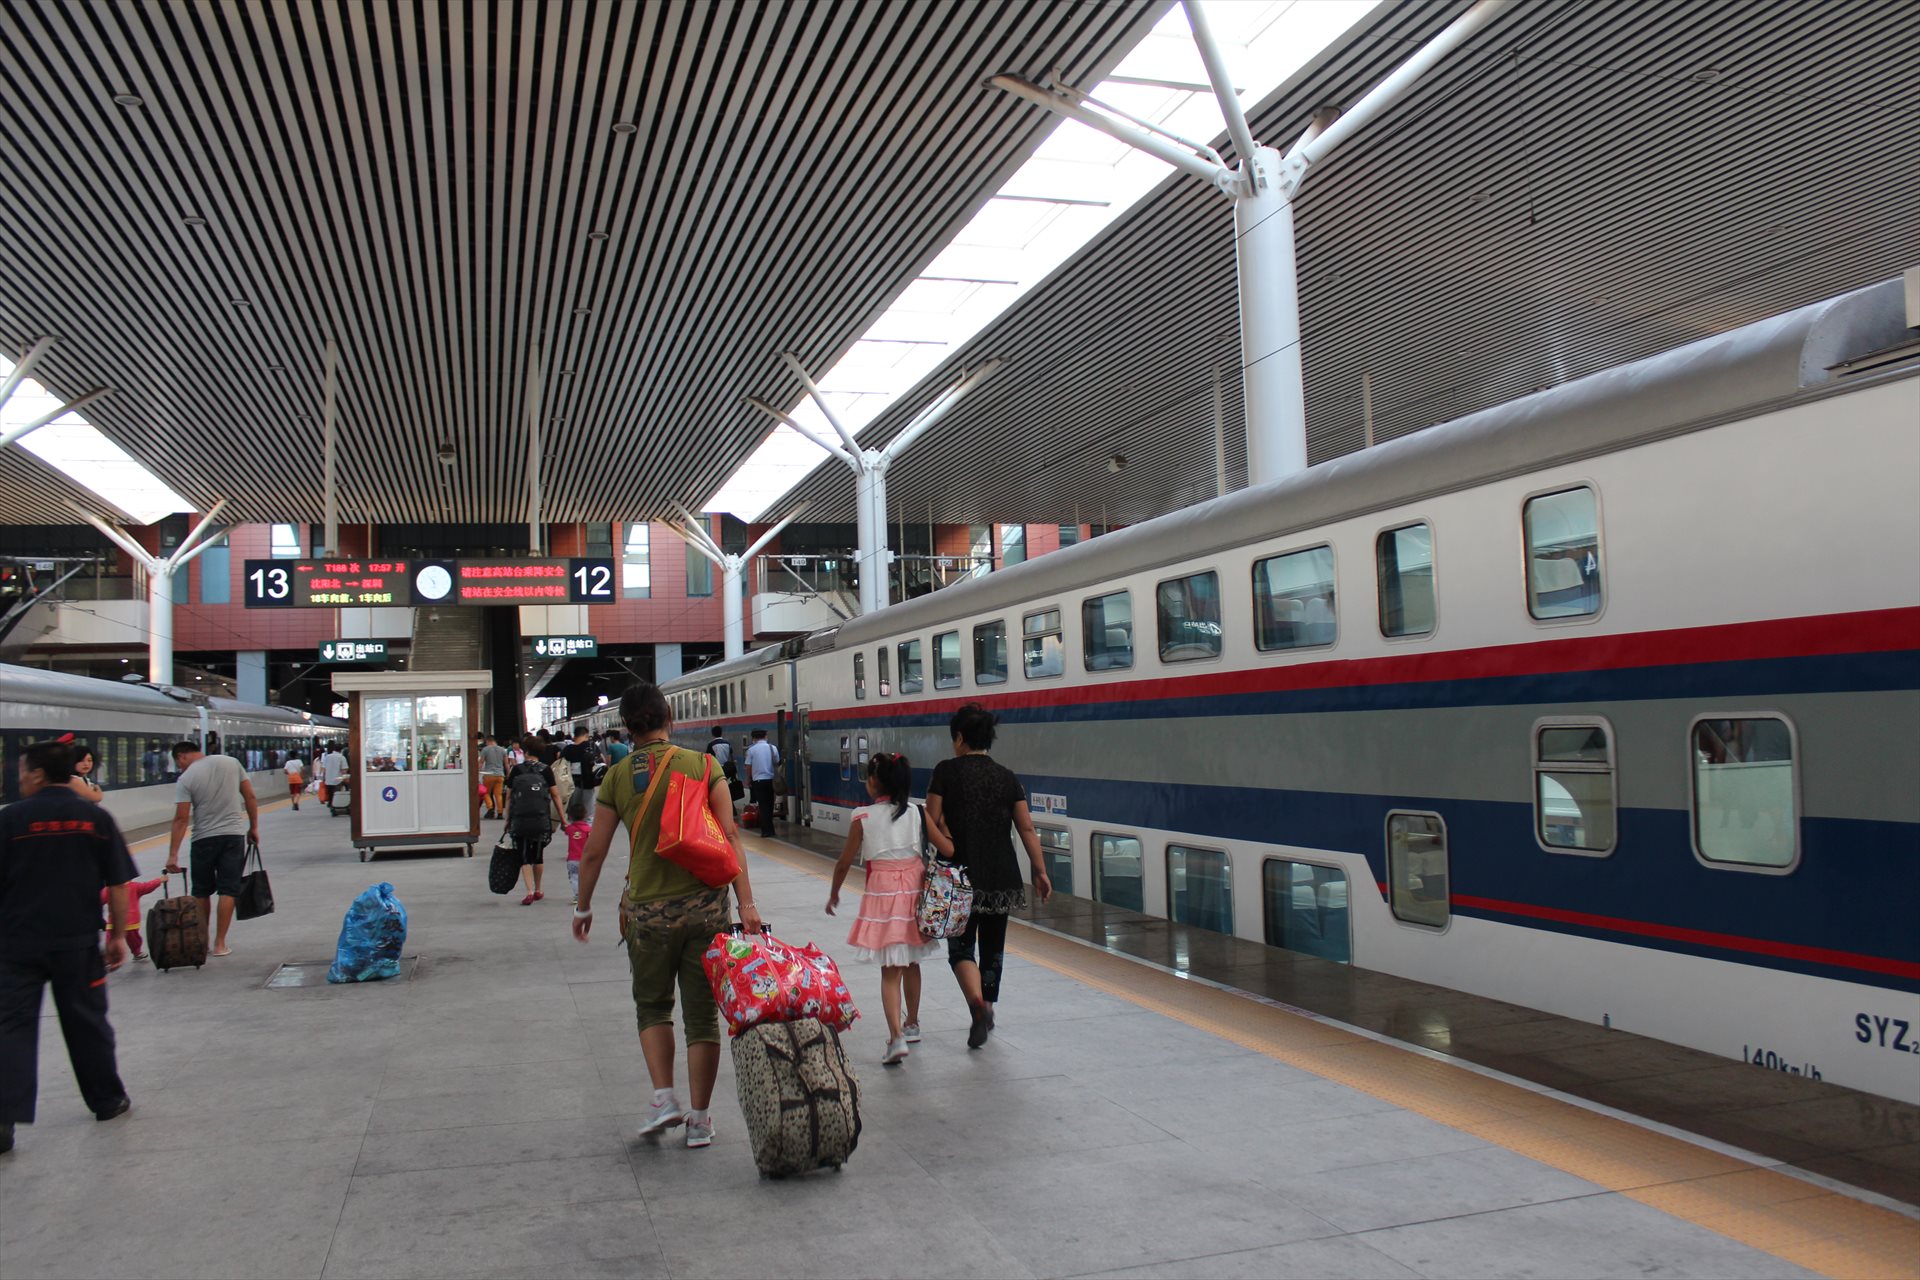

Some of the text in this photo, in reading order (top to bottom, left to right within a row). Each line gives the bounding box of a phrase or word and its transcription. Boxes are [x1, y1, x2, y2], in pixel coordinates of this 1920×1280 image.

[368, 563, 392, 573] 17:57
[250, 568, 289, 599] 13
[574, 566, 611, 596] 12
[461, 586, 566, 598] 请站在安全线以内等候
[355, 643, 384, 653] 出站口
[566, 639, 593, 649] 出站口
[385, 789, 395, 799] 4
